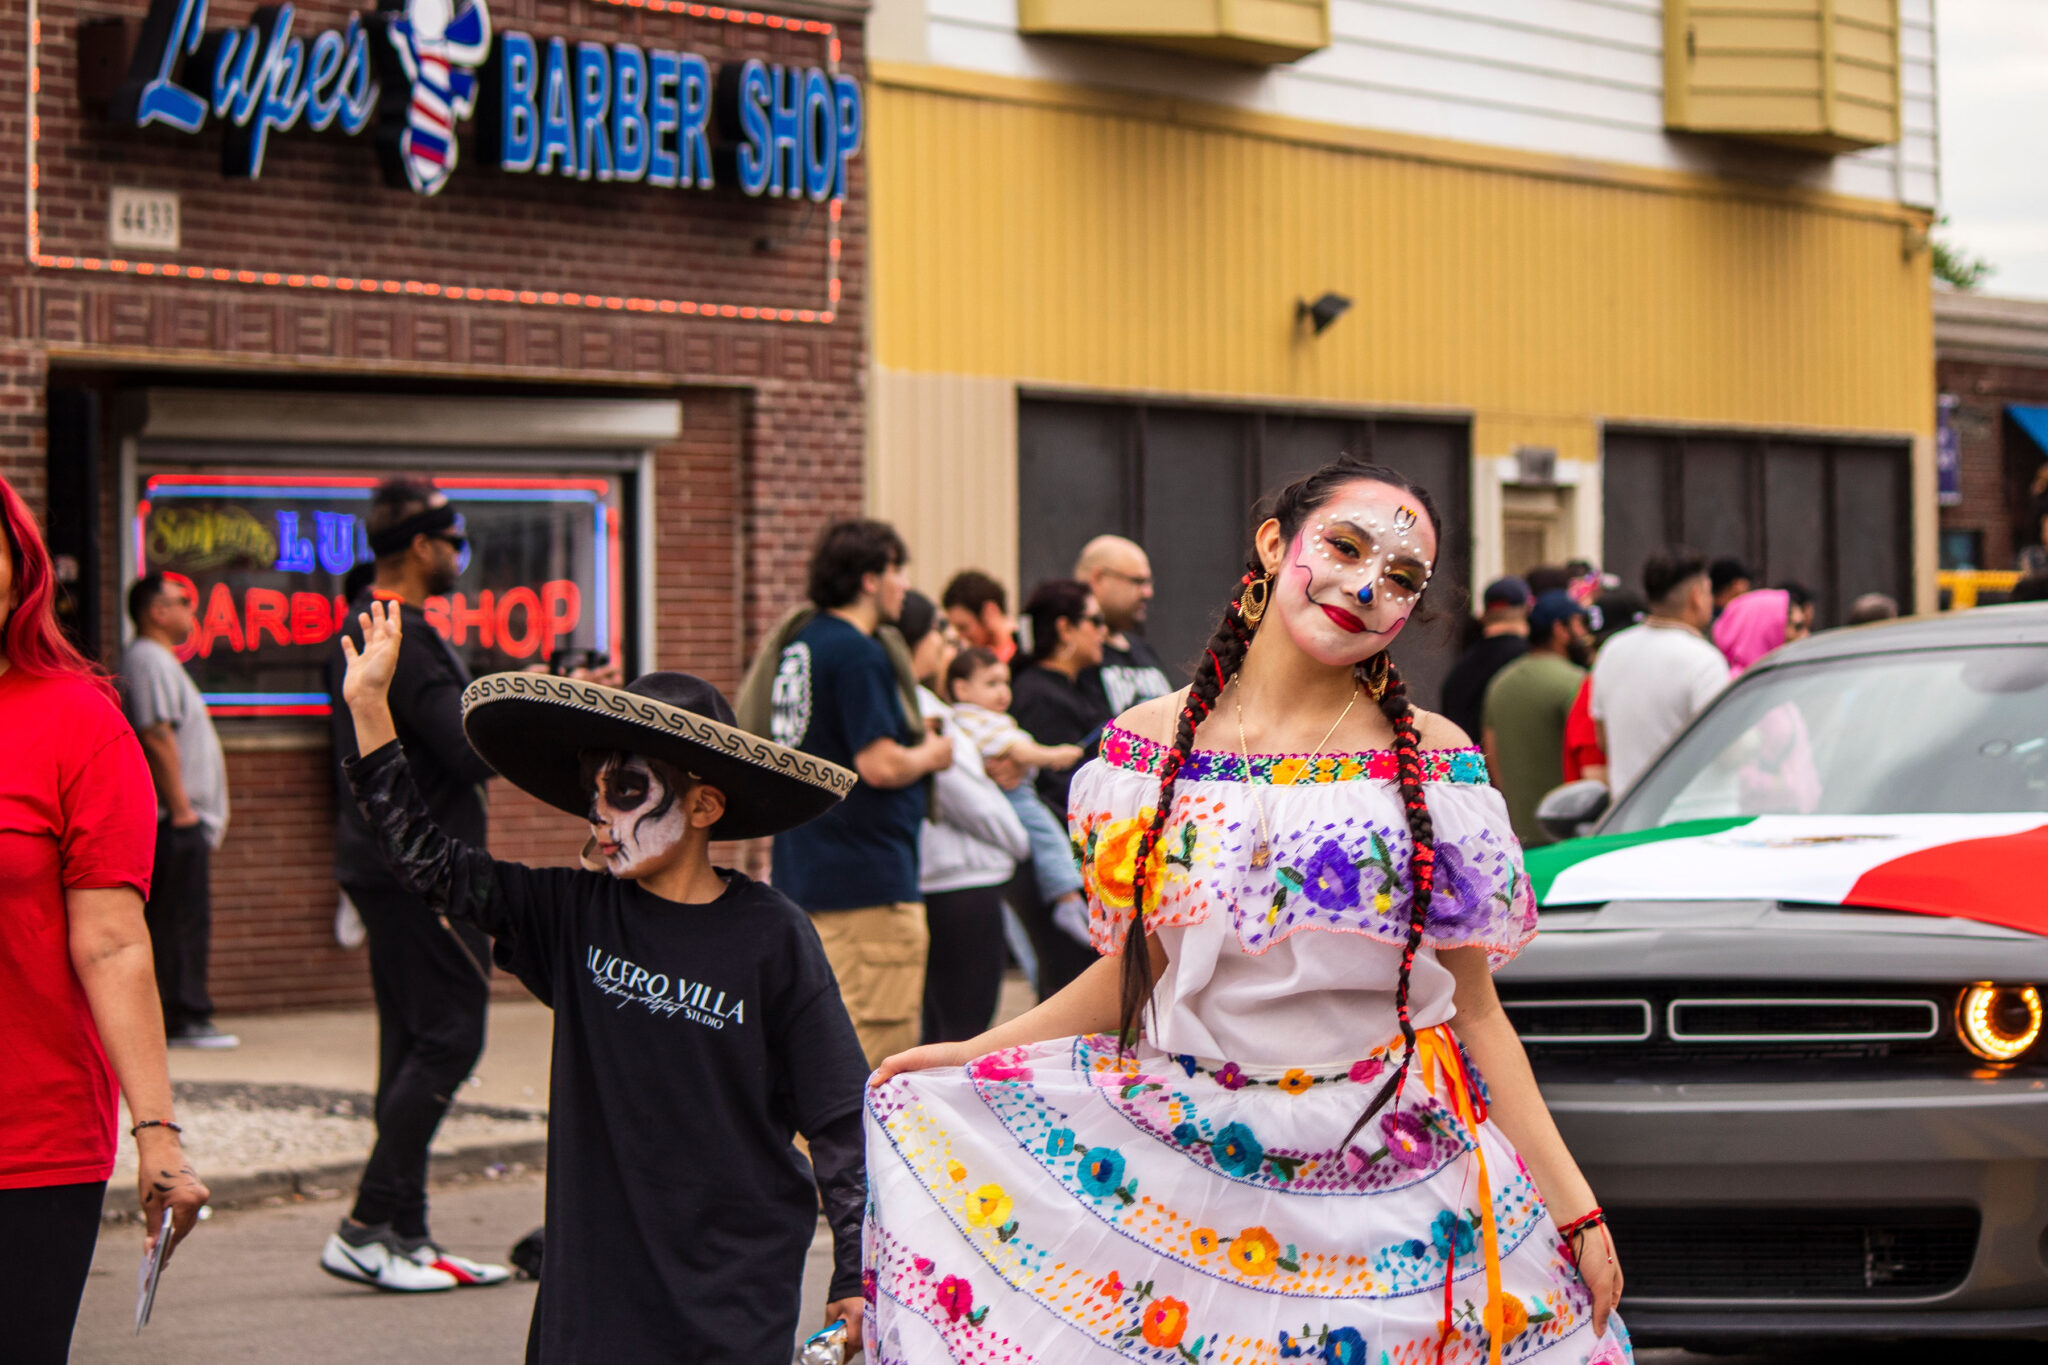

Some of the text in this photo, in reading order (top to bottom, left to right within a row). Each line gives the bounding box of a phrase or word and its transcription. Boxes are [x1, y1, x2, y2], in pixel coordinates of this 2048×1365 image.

[501, 29, 715, 190] BARBER
[736, 58, 864, 202] SHOP
[120, 202, 174, 236] 4433
[424, 579, 581, 661] SHOP
[678, 978, 744, 1025] VILLA
[684, 1007, 725, 1030] STUDIO
